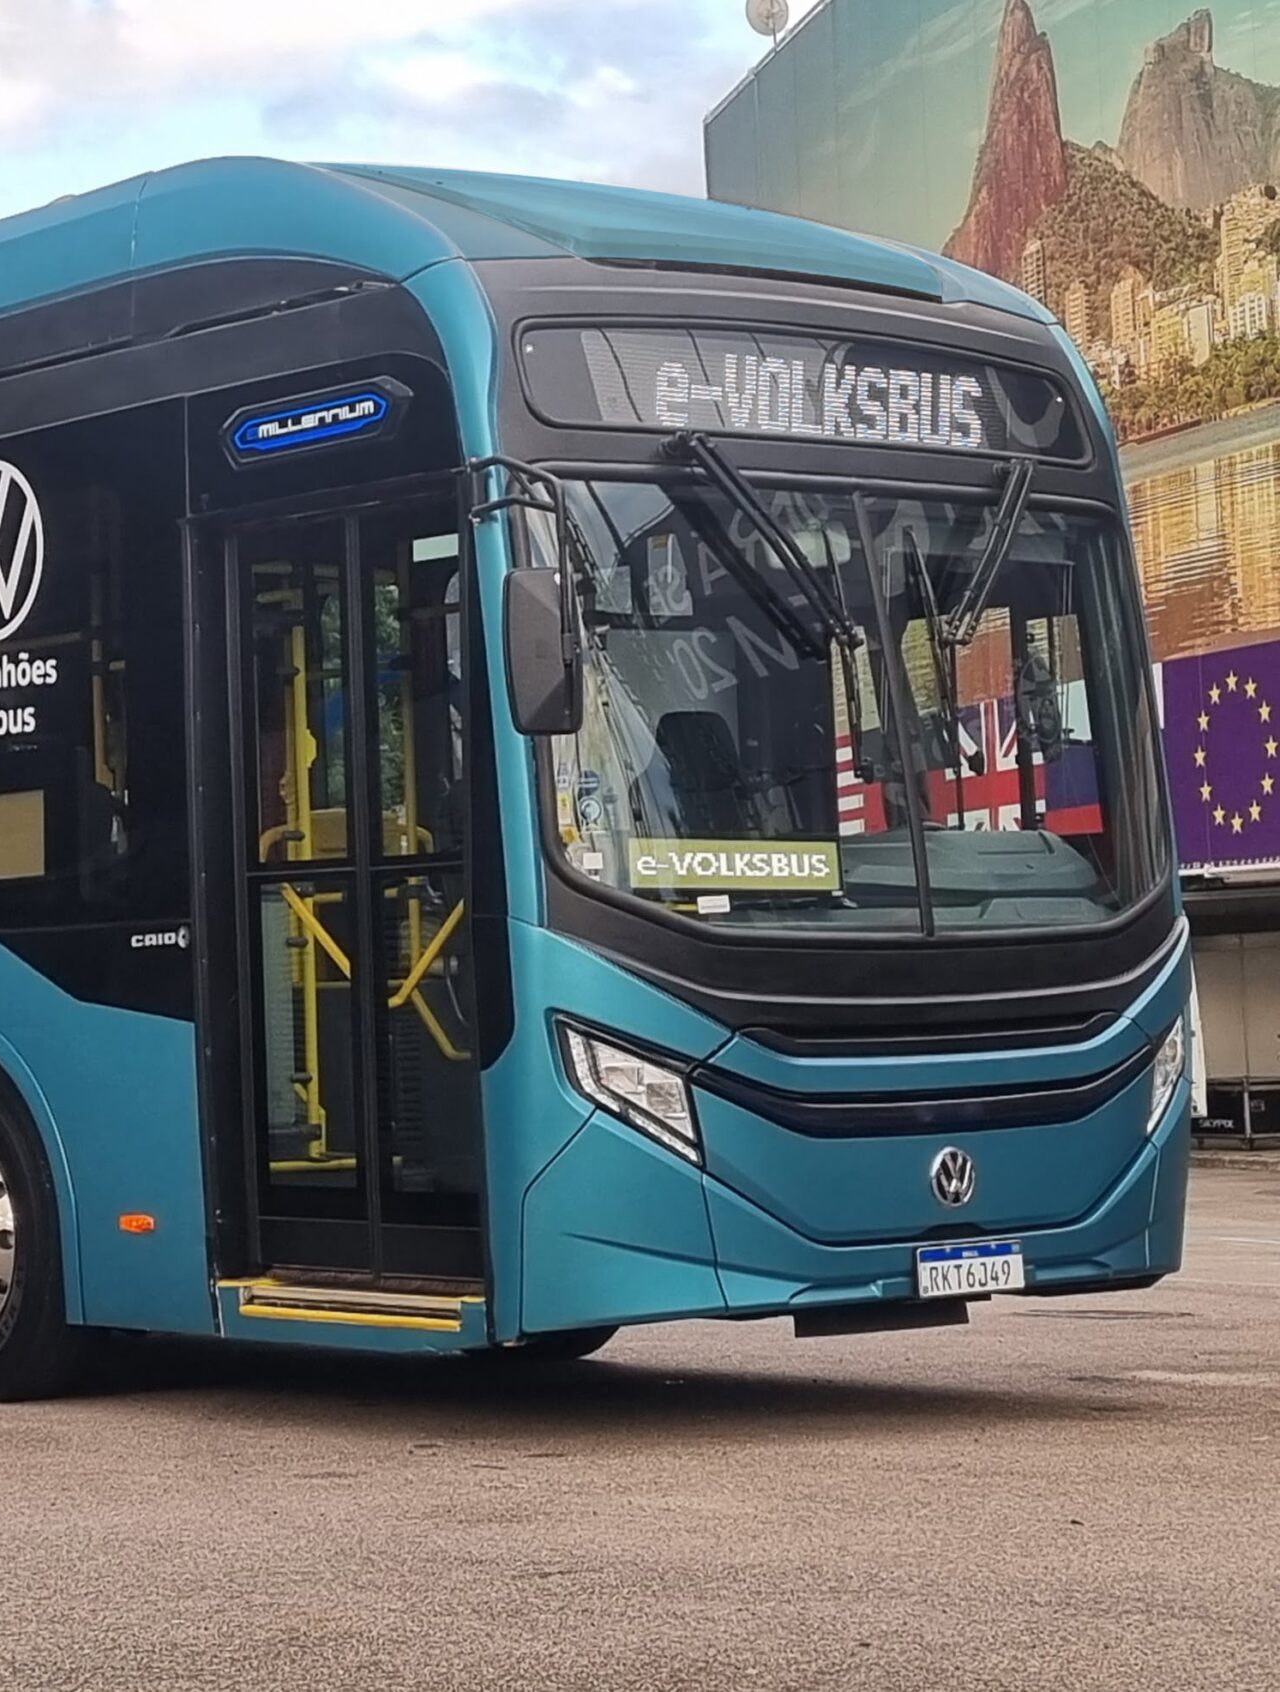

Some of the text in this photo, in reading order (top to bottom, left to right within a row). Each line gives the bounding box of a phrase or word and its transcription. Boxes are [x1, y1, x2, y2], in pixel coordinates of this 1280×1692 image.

[656, 353, 983, 447] e-VOLKSBUS
[636, 851, 831, 879] e-VOLKSBUS
[928, 1259, 1012, 1293] RKT6J49
